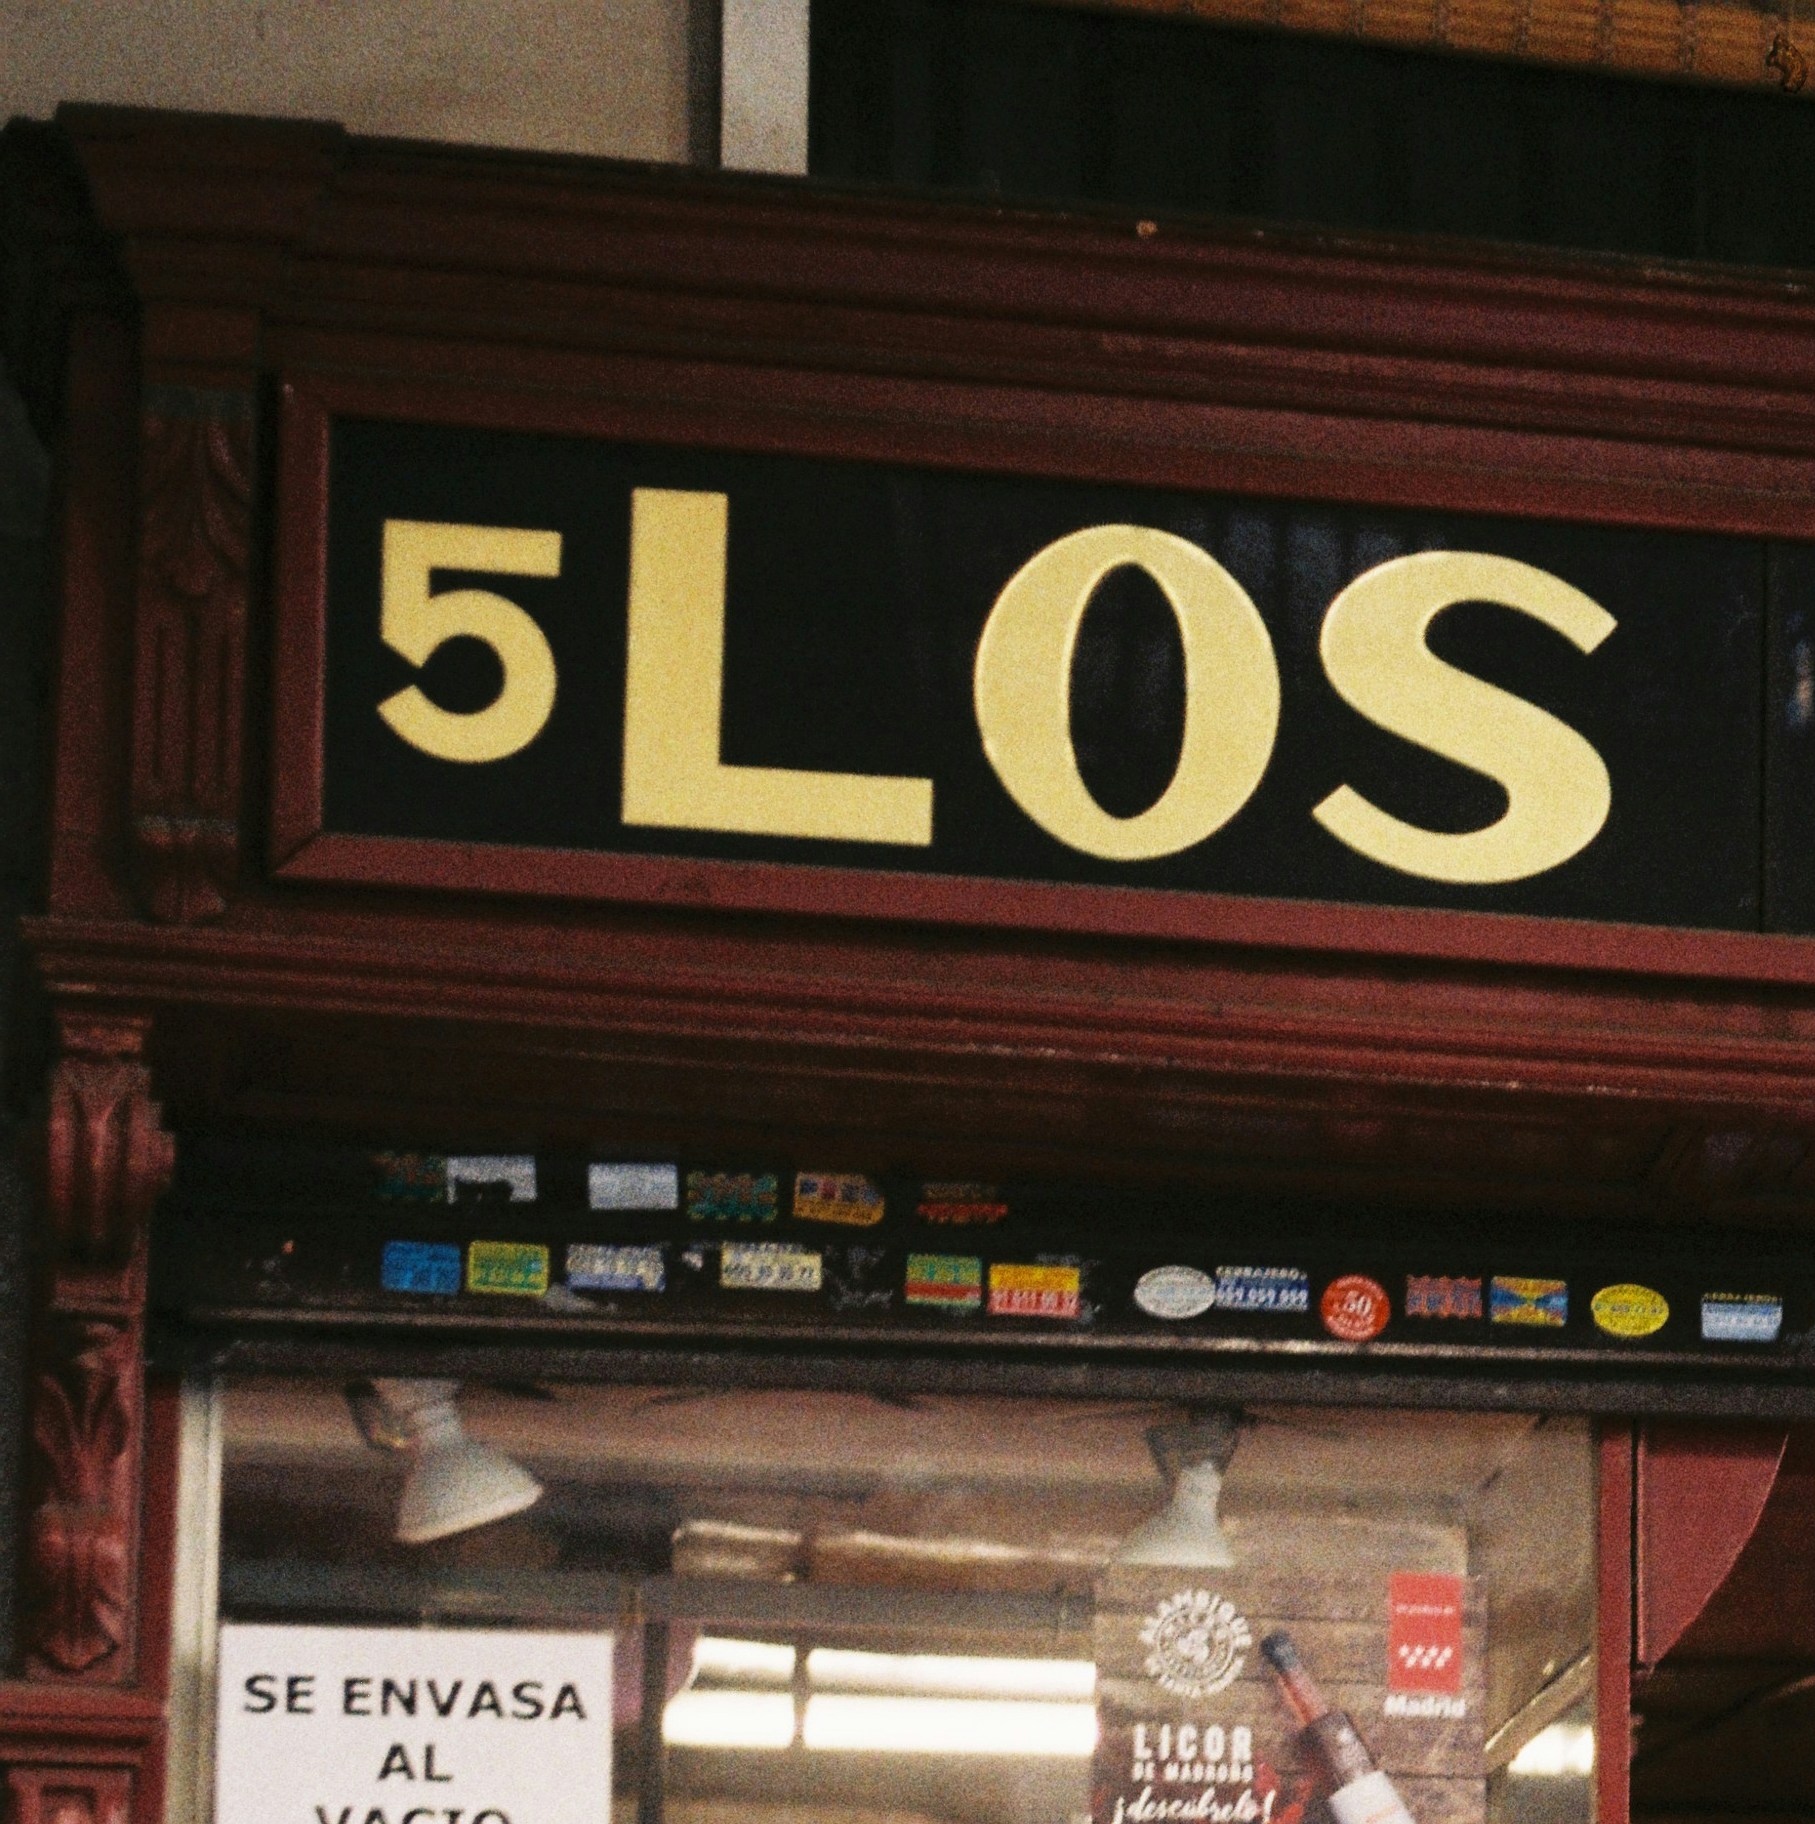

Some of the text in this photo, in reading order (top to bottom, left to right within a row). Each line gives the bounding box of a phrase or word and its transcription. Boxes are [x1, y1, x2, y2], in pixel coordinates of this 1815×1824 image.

[378, 518, 562, 764] 5
[620, 486, 1619, 886] LOS
[243, 1675, 588, 1720] SE ENVASA
[1384, 1694, 1467, 1720] Madrid
[1134, 1724, 1252, 1762] LICOR
[377, 1744, 453, 1782] AL
